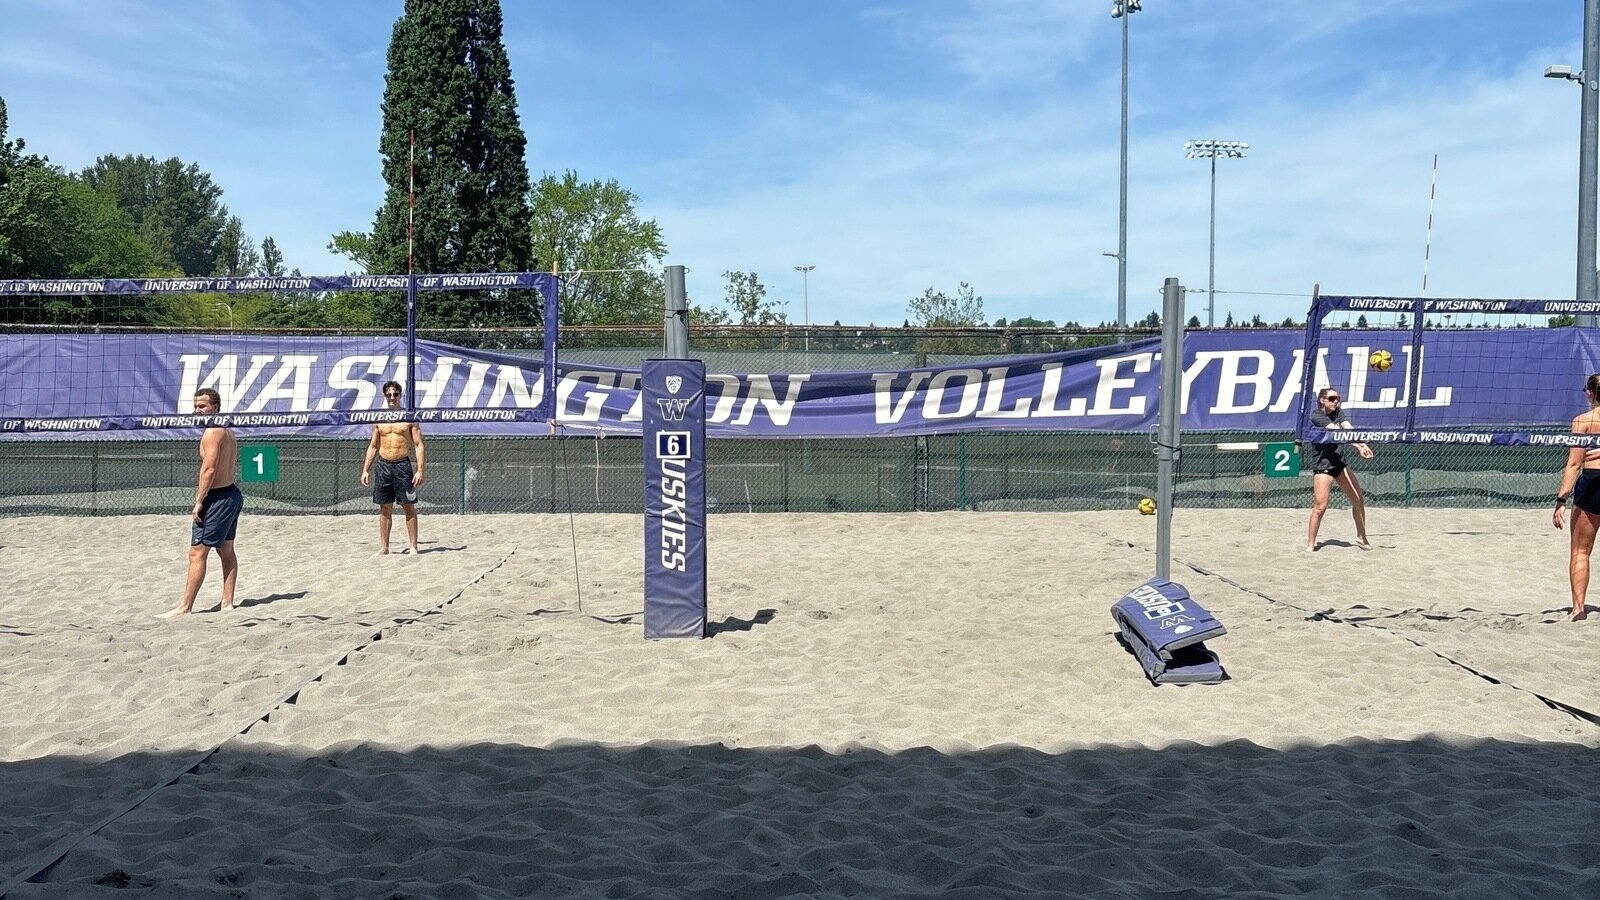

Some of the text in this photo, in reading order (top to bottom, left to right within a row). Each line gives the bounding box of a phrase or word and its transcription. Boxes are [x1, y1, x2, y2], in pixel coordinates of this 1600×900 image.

[28, 282, 105, 292] WASHINGTON
[144, 279, 311, 291] UNIVERSITY OF WASHINGTON
[423, 277, 438, 287] OF
[442, 275, 518, 286] WASHINGTON
[1349, 298, 1416, 310] UNIVERSITY
[872, 345, 1453, 424] VOLLEYBALL
[657, 399, 690, 420] W
[142, 414, 311, 427] UNIVERSITY OF WASHINGTON
[350, 410, 516, 422] UNIVERSI OF WASHINGTON
[3, 419, 102, 430] OF WASHINGTON
[1333, 431, 1400, 441] UNIVERSITY
[1530, 434, 1594, 445] UNIVERSITY
[667, 435, 680, 455] 6
[252, 453, 264, 474] 1
[1274, 450, 1290, 471] 2
[661, 458, 686, 573] USKIES
